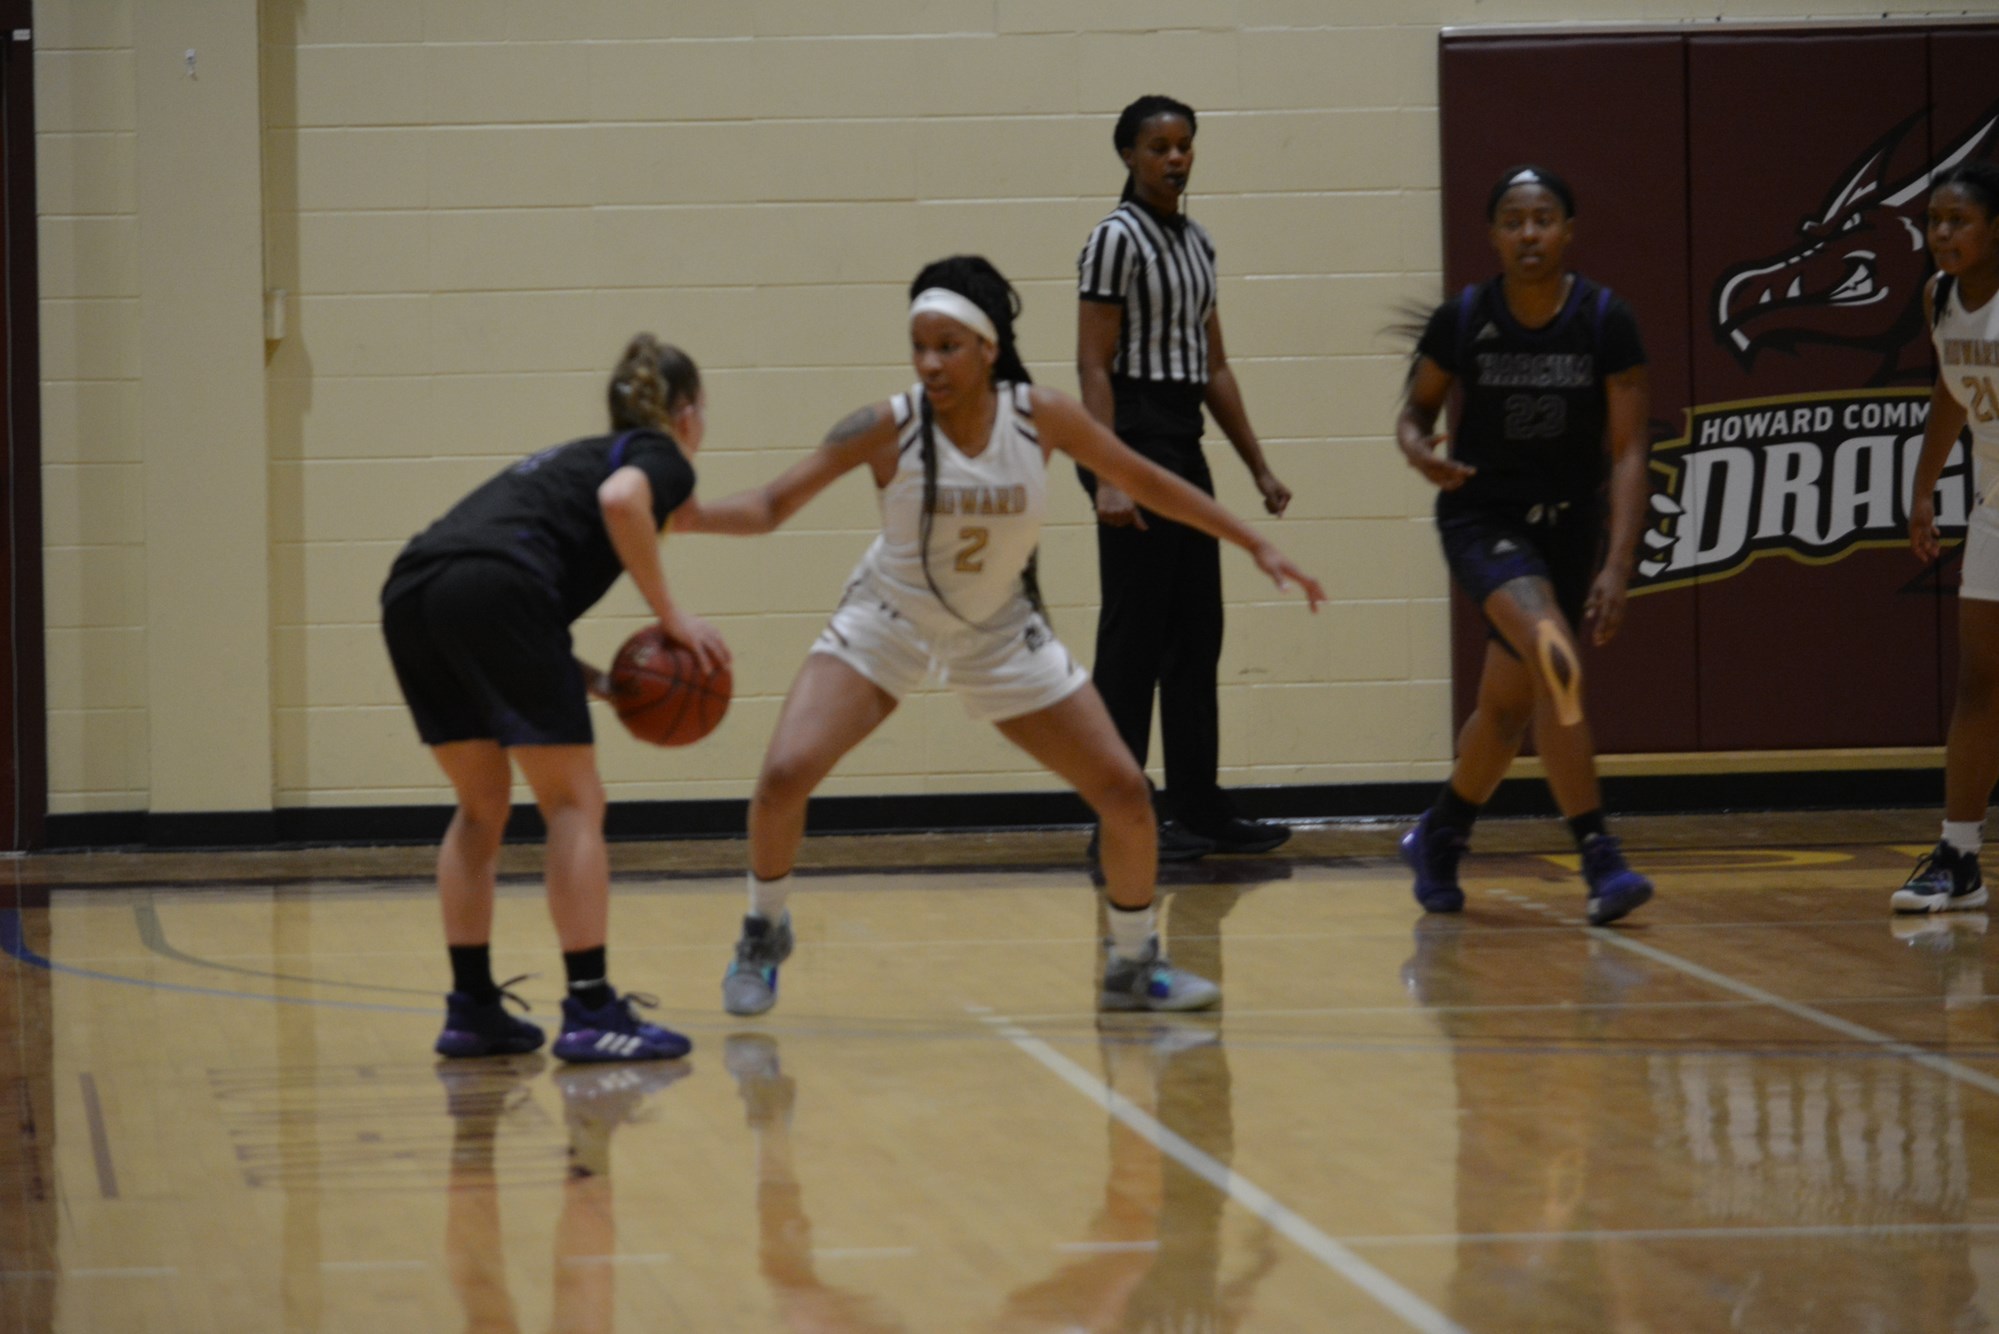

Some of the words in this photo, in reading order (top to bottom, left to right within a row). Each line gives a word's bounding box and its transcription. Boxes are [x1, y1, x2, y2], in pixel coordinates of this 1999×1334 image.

[1699, 406, 1834, 446] HOWARD
[924, 483, 1027, 515] OWARD
[1664, 433, 1969, 572] DRAG
[955, 525, 989, 573] 2
